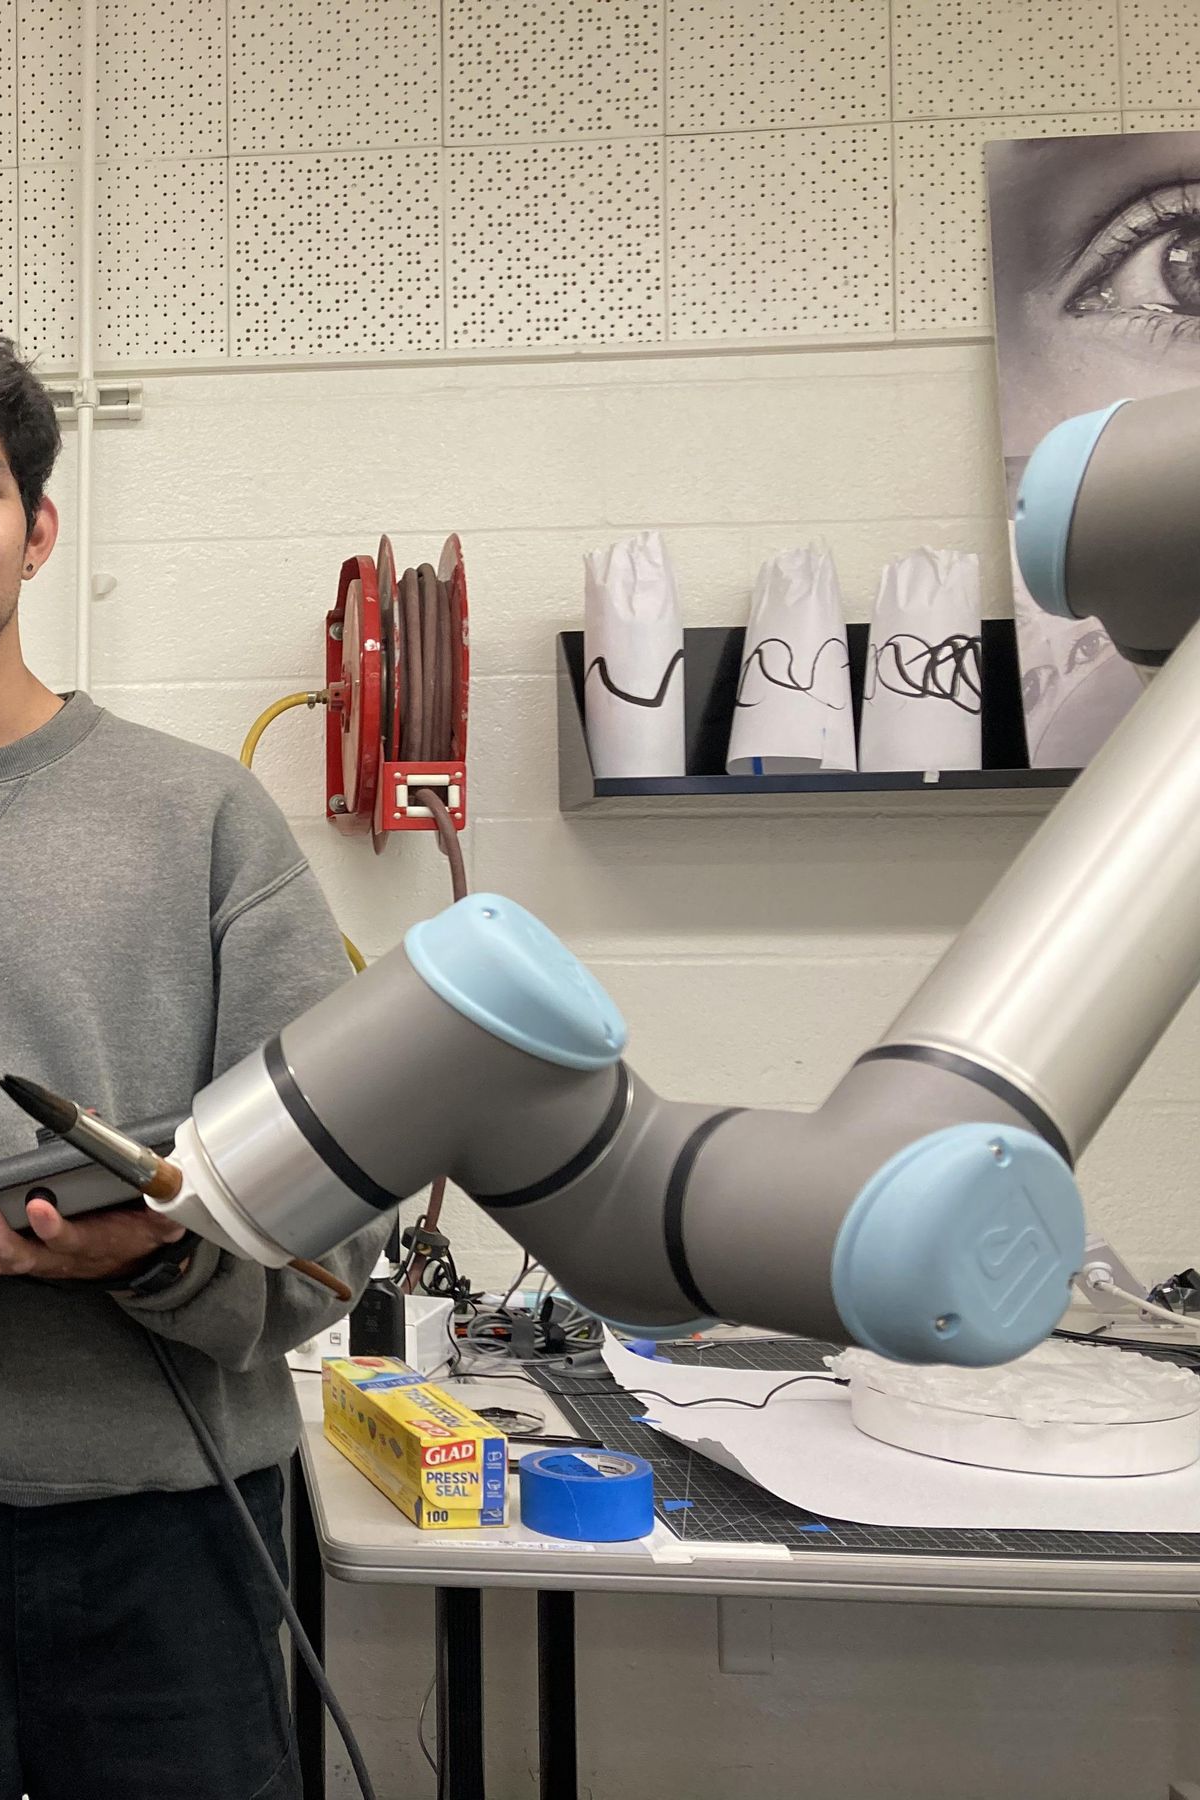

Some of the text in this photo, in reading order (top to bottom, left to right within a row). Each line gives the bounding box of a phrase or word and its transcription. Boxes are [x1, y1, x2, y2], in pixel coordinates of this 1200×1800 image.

[425, 1443, 475, 1466] GLAD
[435, 1484, 471, 1497] SEAL
[426, 1510, 449, 1523] 100
